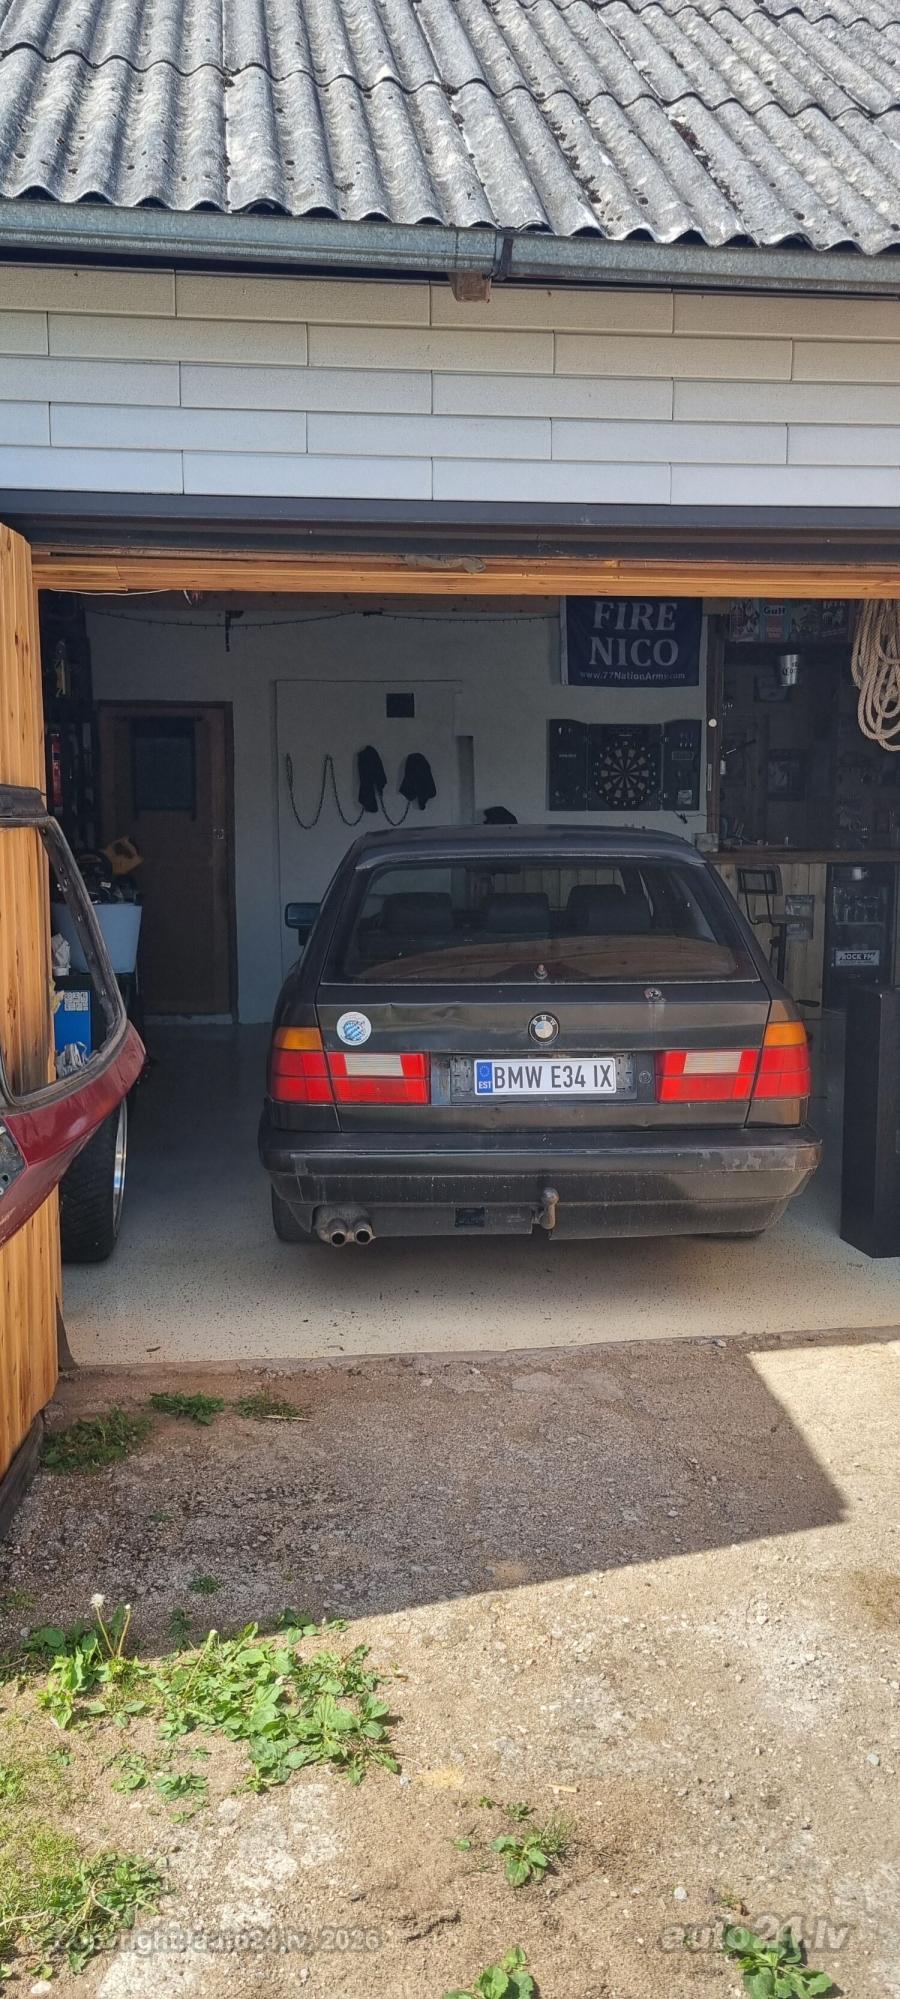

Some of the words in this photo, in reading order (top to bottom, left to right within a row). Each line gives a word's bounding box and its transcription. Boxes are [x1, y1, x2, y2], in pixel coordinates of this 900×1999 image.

[592, 601, 678, 631] FIRE
[588, 636, 679, 666] NICO
[532, 1015, 557, 1026] BMW
[478, 1081, 492, 1089] EST
[494, 1065, 543, 1089] BMW
[551, 1065, 586, 1088] E34
[593, 1064, 612, 1088] IX
